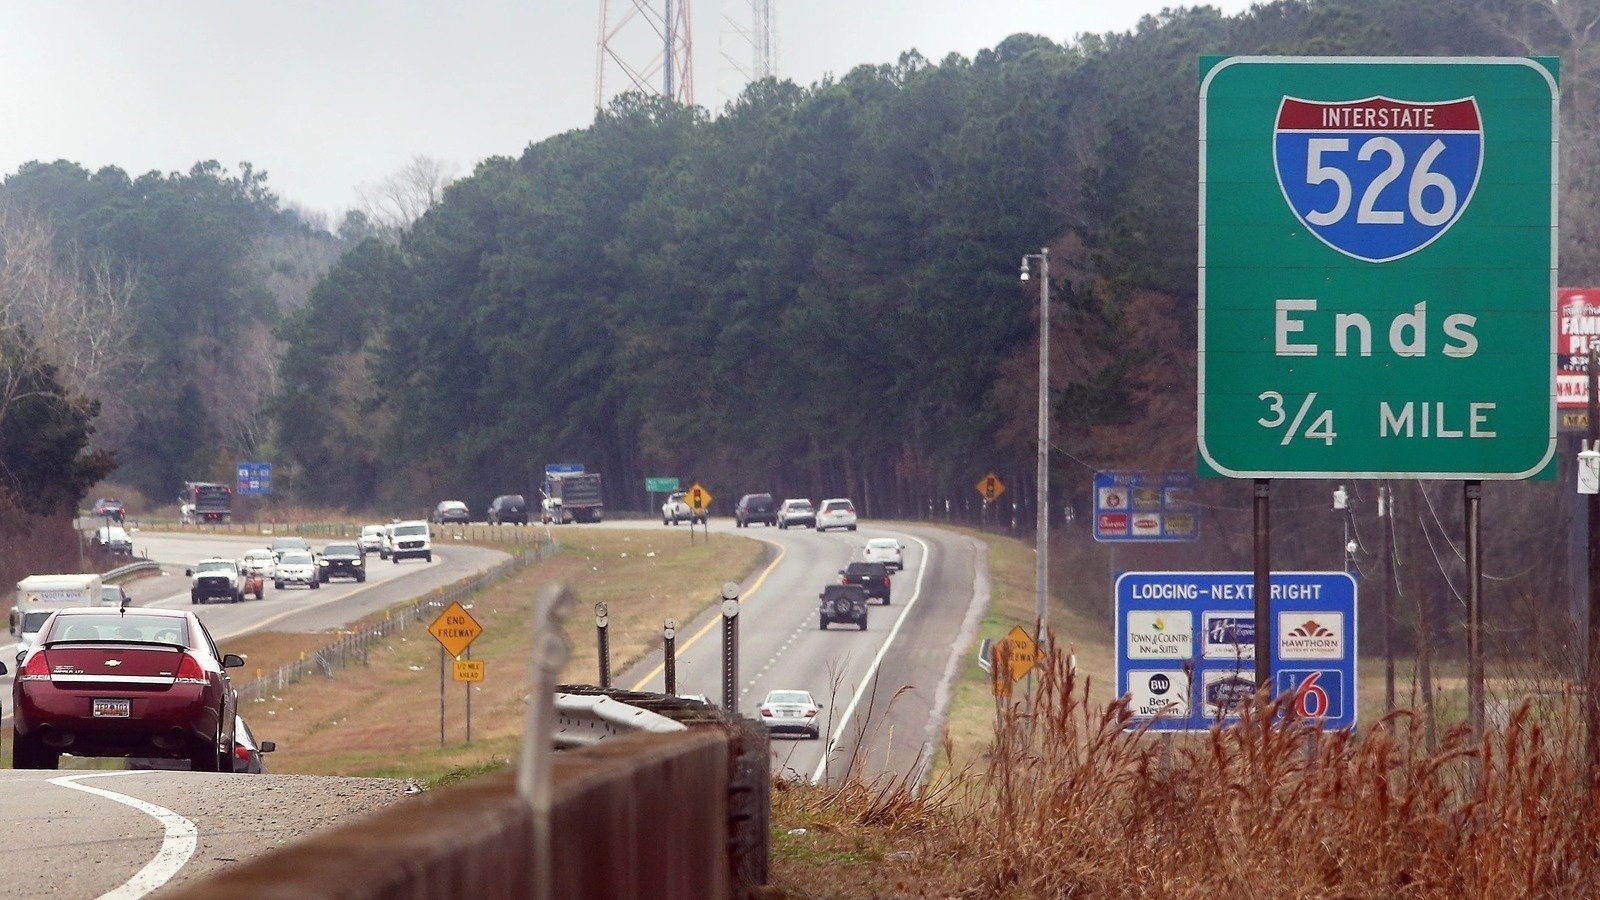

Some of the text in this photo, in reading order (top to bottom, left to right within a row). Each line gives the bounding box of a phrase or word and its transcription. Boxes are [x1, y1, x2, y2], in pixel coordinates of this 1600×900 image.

[1322, 108, 1435, 128] INTERSTATE
[1305, 136, 1458, 227] 526
[1275, 299, 1479, 358] Ends
[1257, 390, 1498, 446] 3/4 MILE
[1270, 584, 1322, 600] RIGHT
[446, 616, 465, 625] END
[437, 628, 474, 638] FREEWAY
[1131, 633, 1151, 643] TOWN
[1158, 633, 1188, 643] COUNTRY
[1281, 639, 1338, 648] HAWTHORN
[1139, 645, 1151, 654] INN
[1150, 680, 1169, 690] BW
[1295, 671, 1328, 717] 6
[1149, 697, 1169, 706] Best
[1140, 706, 1179, 715] Wesrn
